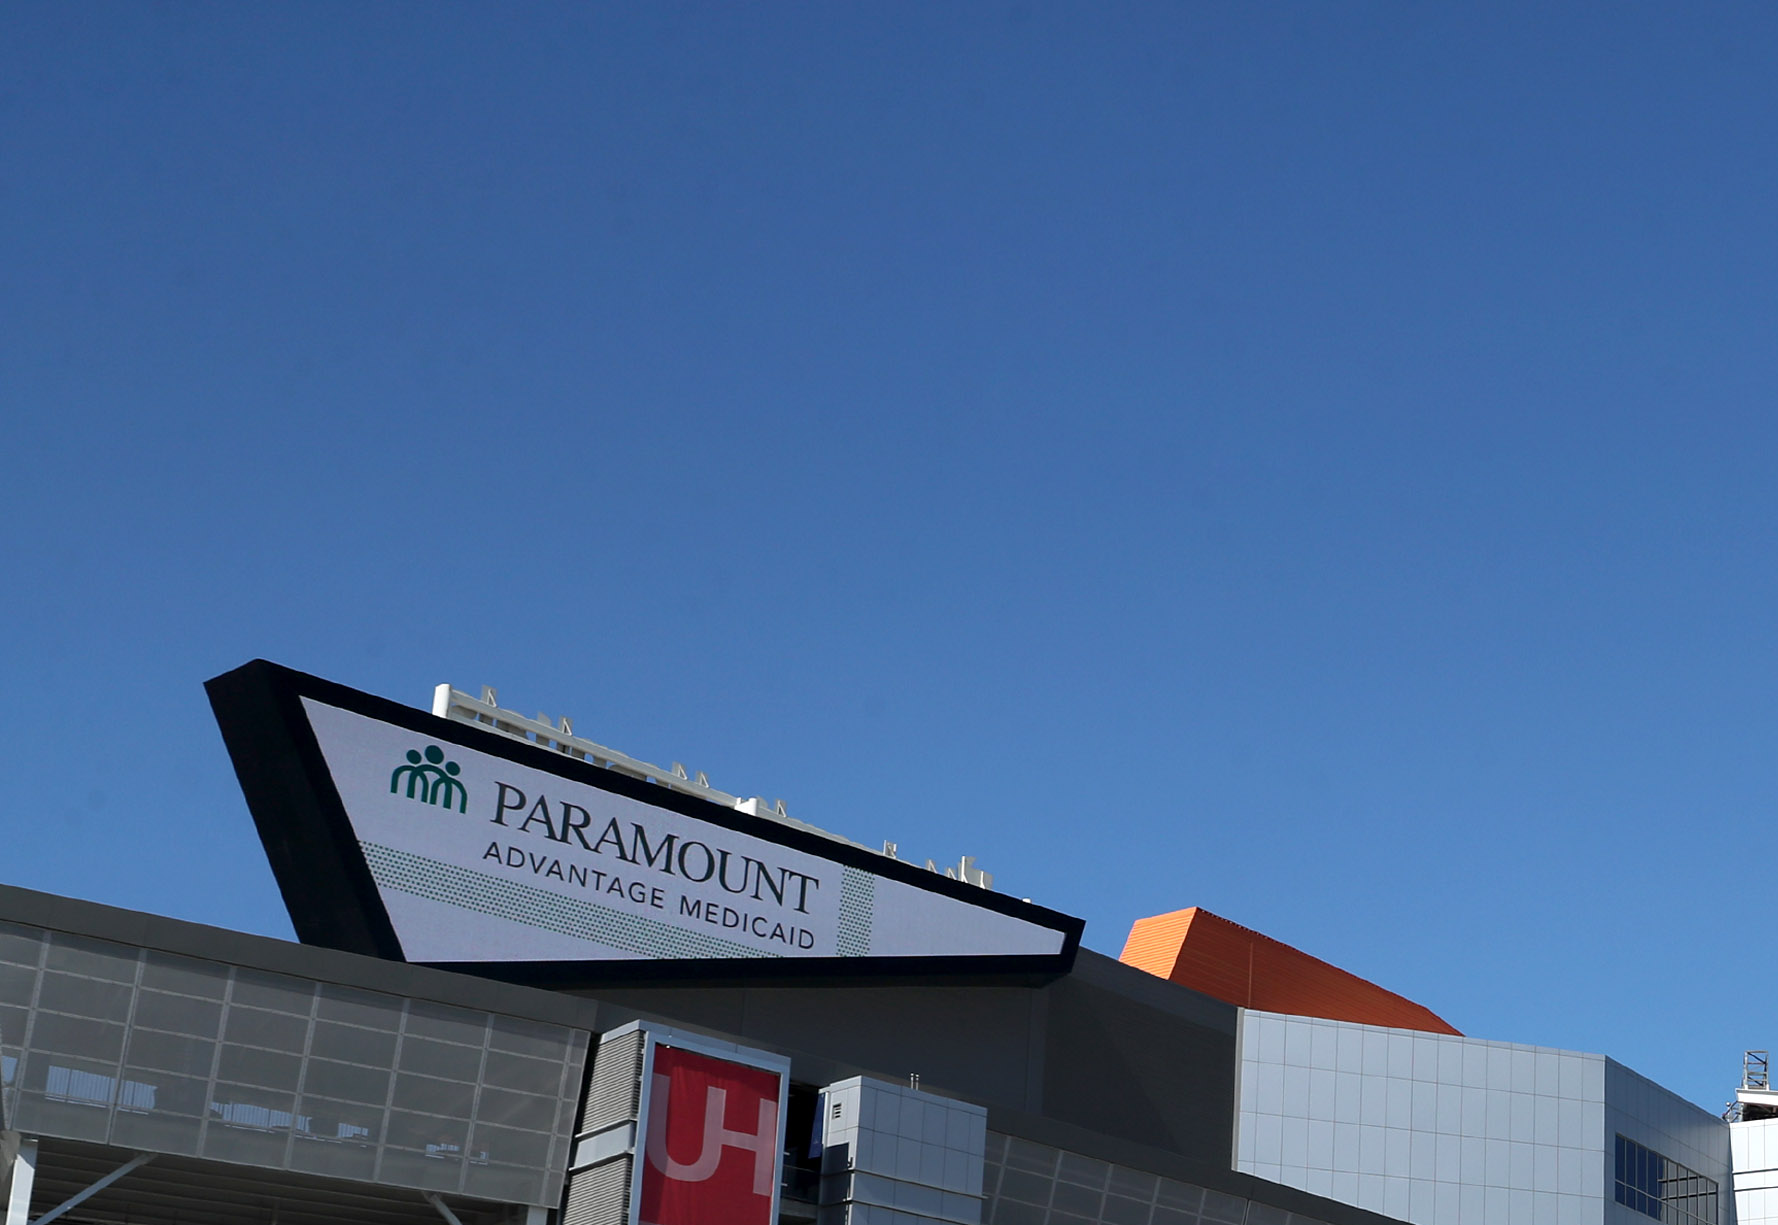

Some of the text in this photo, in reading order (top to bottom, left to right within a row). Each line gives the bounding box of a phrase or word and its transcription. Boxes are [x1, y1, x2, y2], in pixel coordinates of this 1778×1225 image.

[483, 842, 816, 950] ADVANTAGE MEDICAID
[490, 780, 820, 914] PARAMOUNT
[646, 1072, 777, 1197] UH
